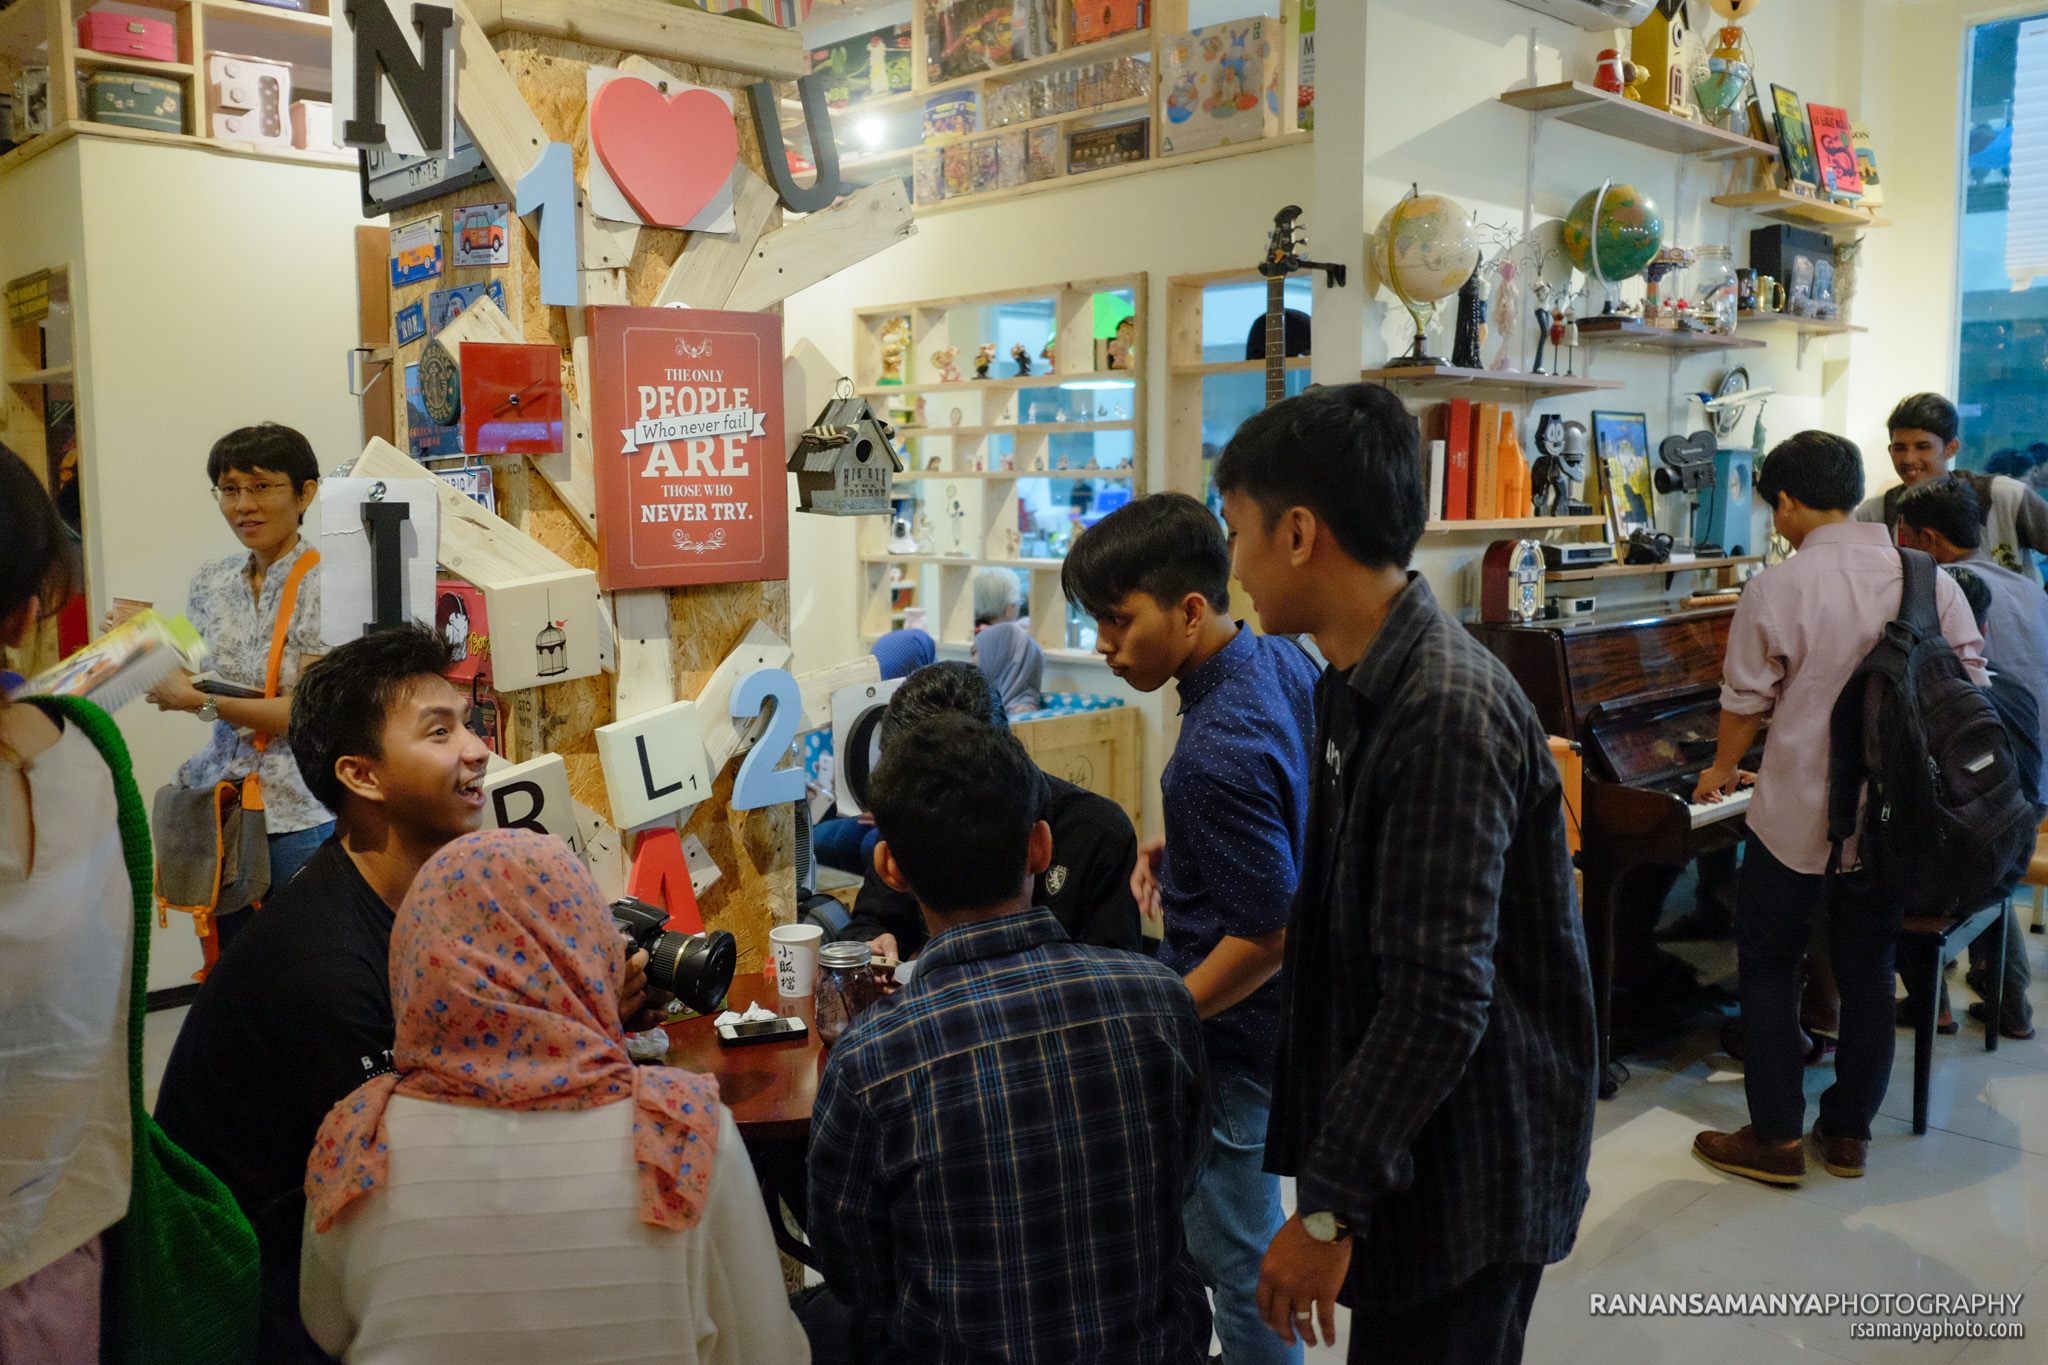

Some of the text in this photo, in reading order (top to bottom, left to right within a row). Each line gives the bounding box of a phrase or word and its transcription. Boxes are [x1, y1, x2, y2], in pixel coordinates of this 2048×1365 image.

[343, 0, 452, 149] N
[744, 70, 841, 213] U
[664, 368, 724, 383] THE ONLY
[426, 400, 452, 420] COFFEE
[638, 385, 750, 421] PEOPLE
[642, 411, 748, 440] Who never fail
[641, 433, 749, 478] ARE
[661, 484, 733, 498] THOSE WHO
[843, 468, 886, 487] HIS EYE
[843, 488, 886, 498] SPARROW
[641, 502, 754, 523] NEVER TRY.
[729, 668, 806, 811] 2
[635, 735, 683, 801] L
[492, 780, 549, 835] R
[627, 826, 706, 935] A
